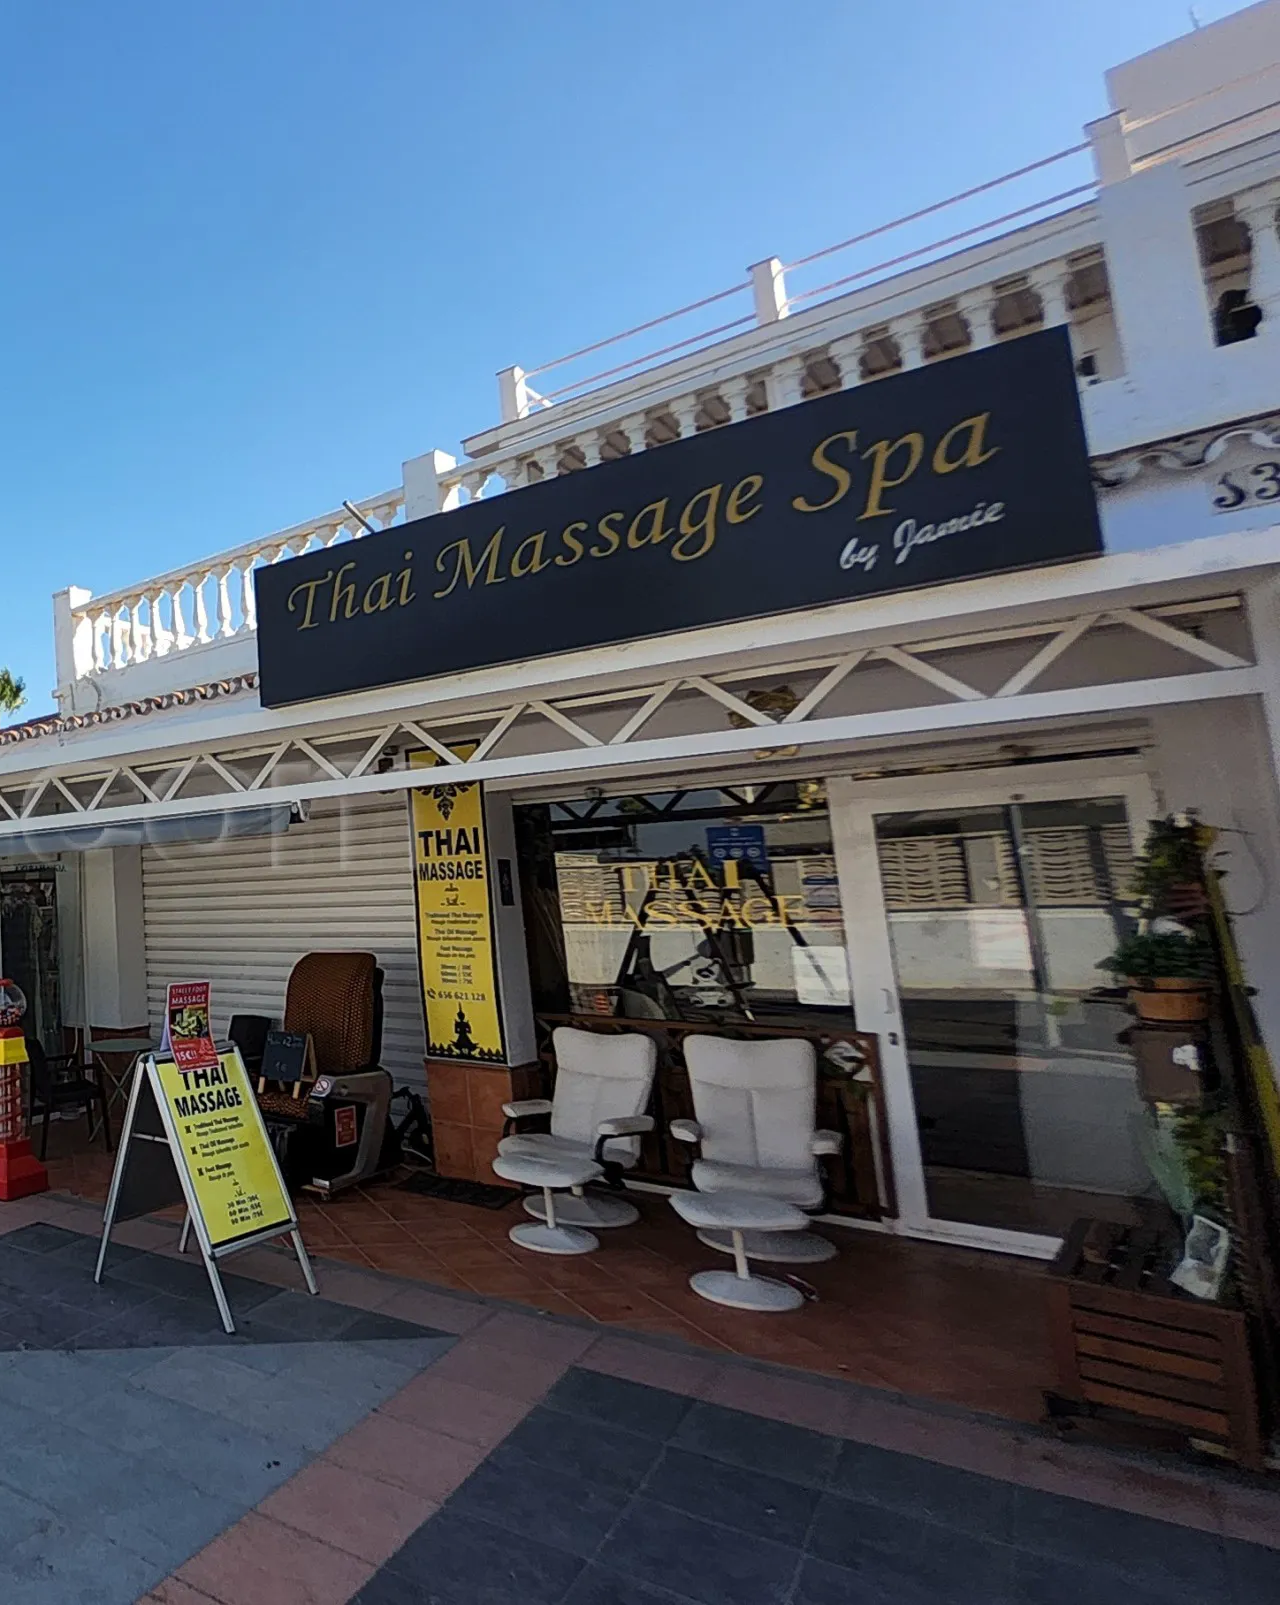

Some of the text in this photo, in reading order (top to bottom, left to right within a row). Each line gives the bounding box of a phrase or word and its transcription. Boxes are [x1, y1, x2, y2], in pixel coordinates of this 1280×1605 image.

[288, 411, 1002, 631] Thai Massage Spa
[840, 502, 1006, 571] by Jamie
[418, 827, 481, 857] THAI
[418, 860, 484, 881] MASSAGE
[617, 860, 742, 893] THAI
[585, 894, 804, 930] MASSAGE
[172, 994, 206, 1004] MASSAGE
[454, 992, 469, 1000] 621
[180, 1062, 228, 1091] THAI
[174, 1087, 243, 1118] MASSAGE
